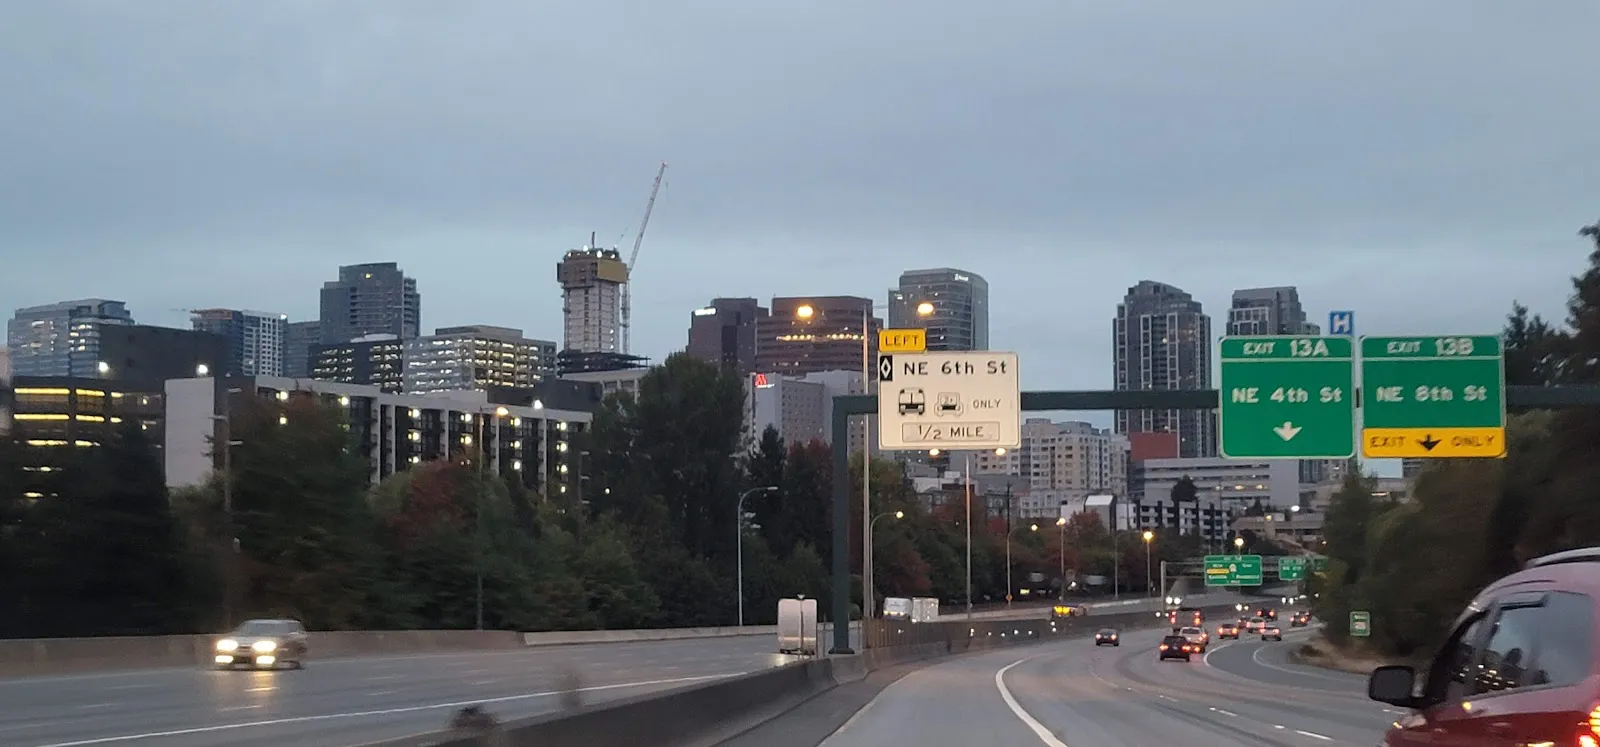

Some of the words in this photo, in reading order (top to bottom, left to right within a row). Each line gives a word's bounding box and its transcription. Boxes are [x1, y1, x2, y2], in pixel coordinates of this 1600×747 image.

[1333, 314, 1350, 333] H
[885, 335, 919, 347] LEFT
[1243, 341, 1276, 355] EXIT
[1290, 339, 1329, 357] 13A
[1387, 340, 1421, 354] EXIT
[1435, 338, 1474, 356] 13B
[904, 361, 929, 376] NE
[941, 360, 974, 376] 6th
[987, 360, 1008, 375] St
[1231, 387, 1260, 403] NE
[1270, 386, 1309, 403] 4th
[1319, 386, 1343, 403] St
[1376, 386, 1404, 402] NE
[1415, 385, 1453, 402] 8th
[1463, 385, 1487, 402] St
[972, 398, 1002, 409] ONLY
[950, 426, 984, 438] MILE
[1370, 436, 1406, 448] EXIT
[1451, 435, 1494, 447] ONLY
